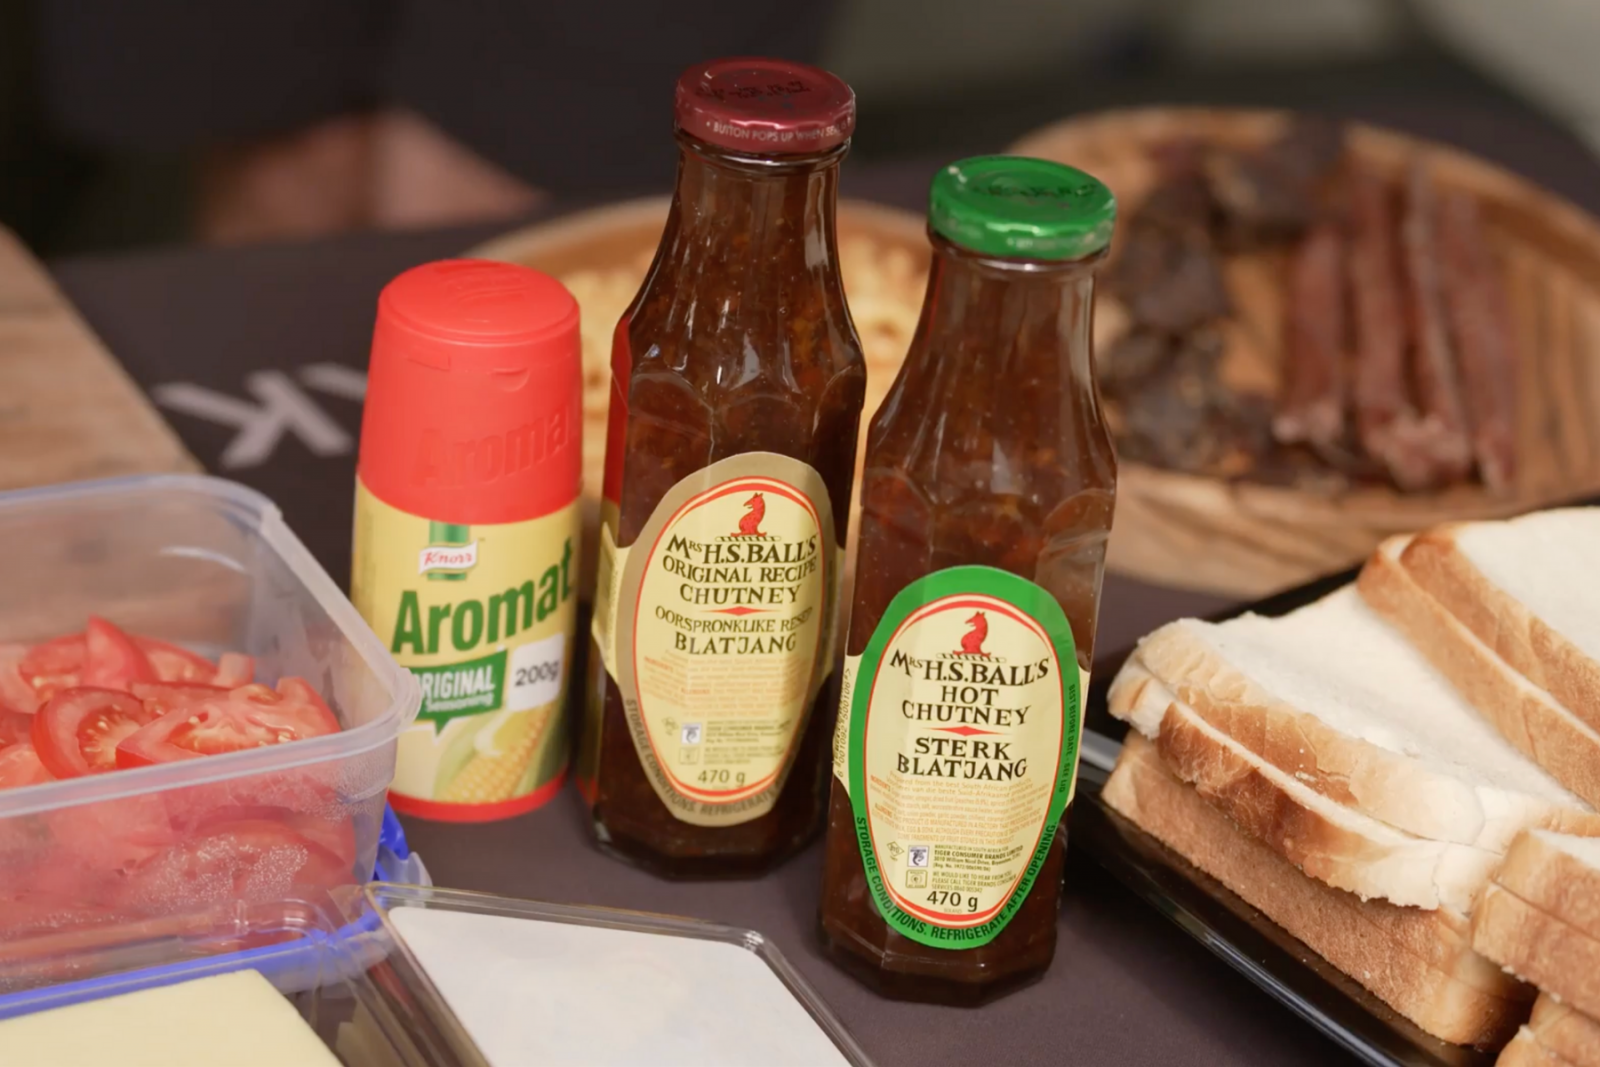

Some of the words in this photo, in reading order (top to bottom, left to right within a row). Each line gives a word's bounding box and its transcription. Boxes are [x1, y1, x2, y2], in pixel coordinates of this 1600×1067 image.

[713, 122, 750, 140] BUTTON
[752, 129, 778, 142] POPS
[781, 131, 794, 142] UP
[409, 403, 576, 489] Aroma
[424, 551, 473, 566] Knorr
[663, 554, 752, 584] ORIGINAL
[760, 556, 816, 584] RECIPE
[391, 538, 573, 655] Aromat
[680, 583, 802, 605] CHUTNEY
[656, 606, 776, 632] OORSPRONKLIKE
[675, 631, 796, 655] BLATJANG
[514, 659, 559, 687] 200g
[940, 684, 999, 706] HOT
[626, 698, 647, 748] STORAGE
[902, 700, 1032, 726] CHUTNEY
[915, 737, 1012, 760] STERK
[1066, 736, 1074, 755] DATE
[897, 752, 1028, 781] BLATJANG
[1062, 763, 1070, 778] SEE
[698, 770, 730, 784] 470
[736, 772, 746, 788] g
[1058, 780, 1068, 793] LID
[856, 816, 878, 874] STORAGE
[930, 912, 1007, 940] REFRIGERATE
[1006, 878, 1030, 912] AFTER
[926, 890, 962, 906] 470
[967, 896, 978, 912] g
